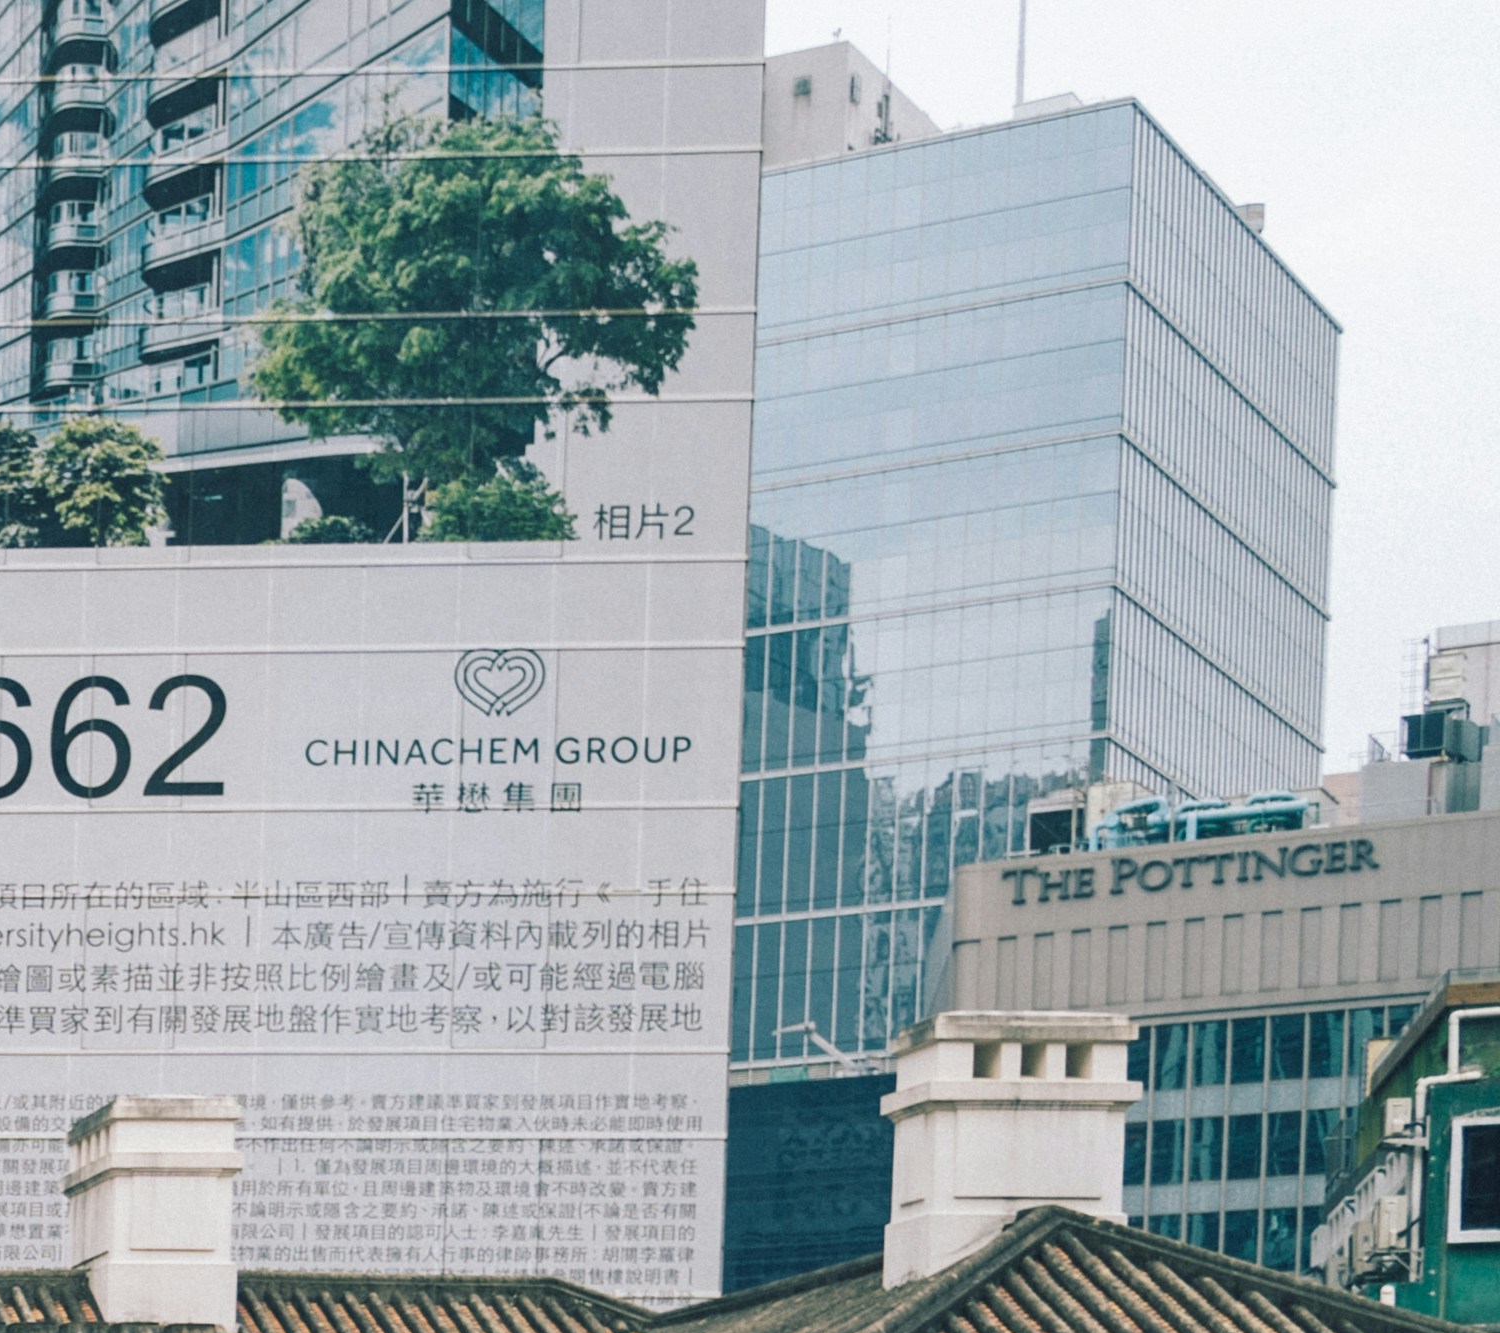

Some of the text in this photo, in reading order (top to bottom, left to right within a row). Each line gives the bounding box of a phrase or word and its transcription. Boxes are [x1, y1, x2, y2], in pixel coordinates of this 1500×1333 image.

[593, 503, 695, 542] 相片2
[305, 735, 693, 768] CHINACHEM GROUP
[411, 781, 584, 815] 華懋集團
[1108, 837, 1381, 896] POTTINGER
